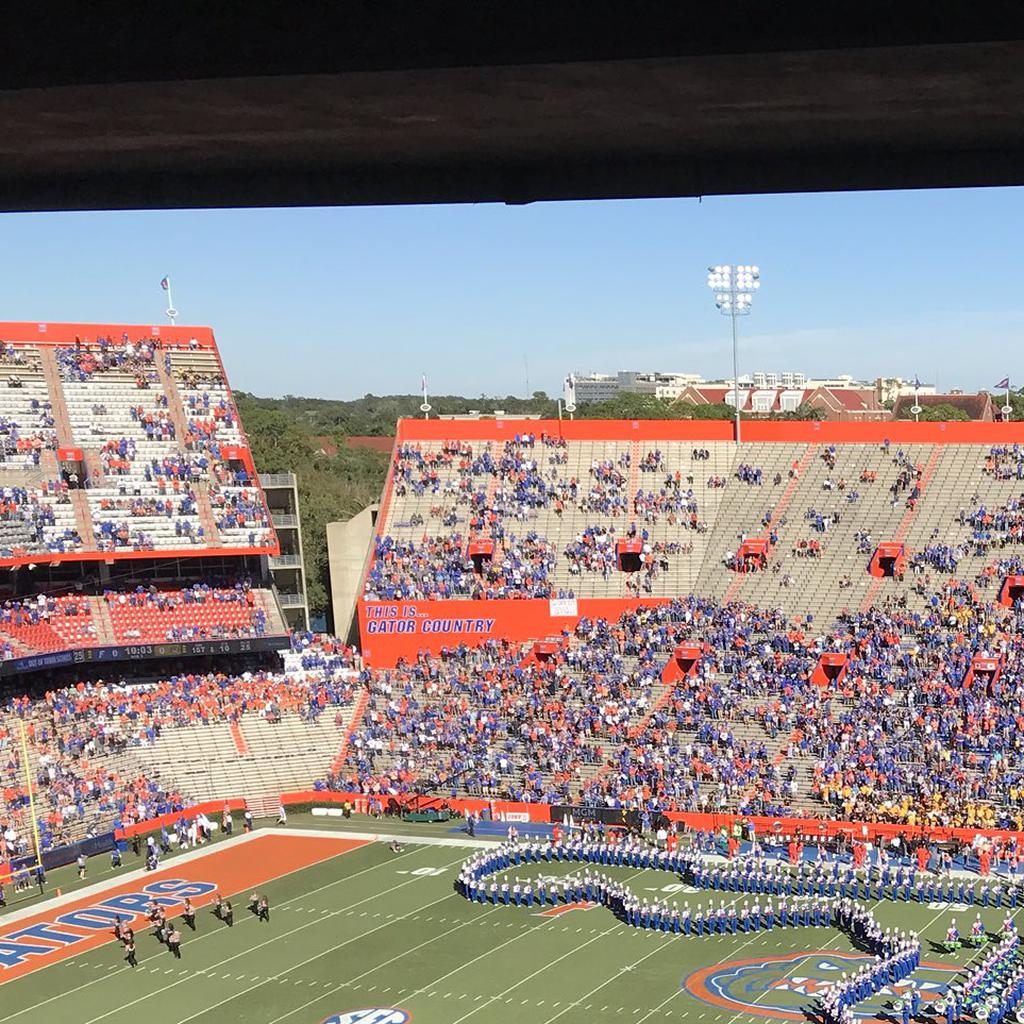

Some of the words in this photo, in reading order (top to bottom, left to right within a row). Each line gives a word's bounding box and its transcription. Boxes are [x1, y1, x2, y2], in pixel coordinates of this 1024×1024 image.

[365, 606, 397, 618] THIS
[367, 619, 416, 633] GATOR
[422, 619, 495, 633] COUNTRY
[124, 646, 153, 655] 10:03
[572, 808, 596, 817] MGM
